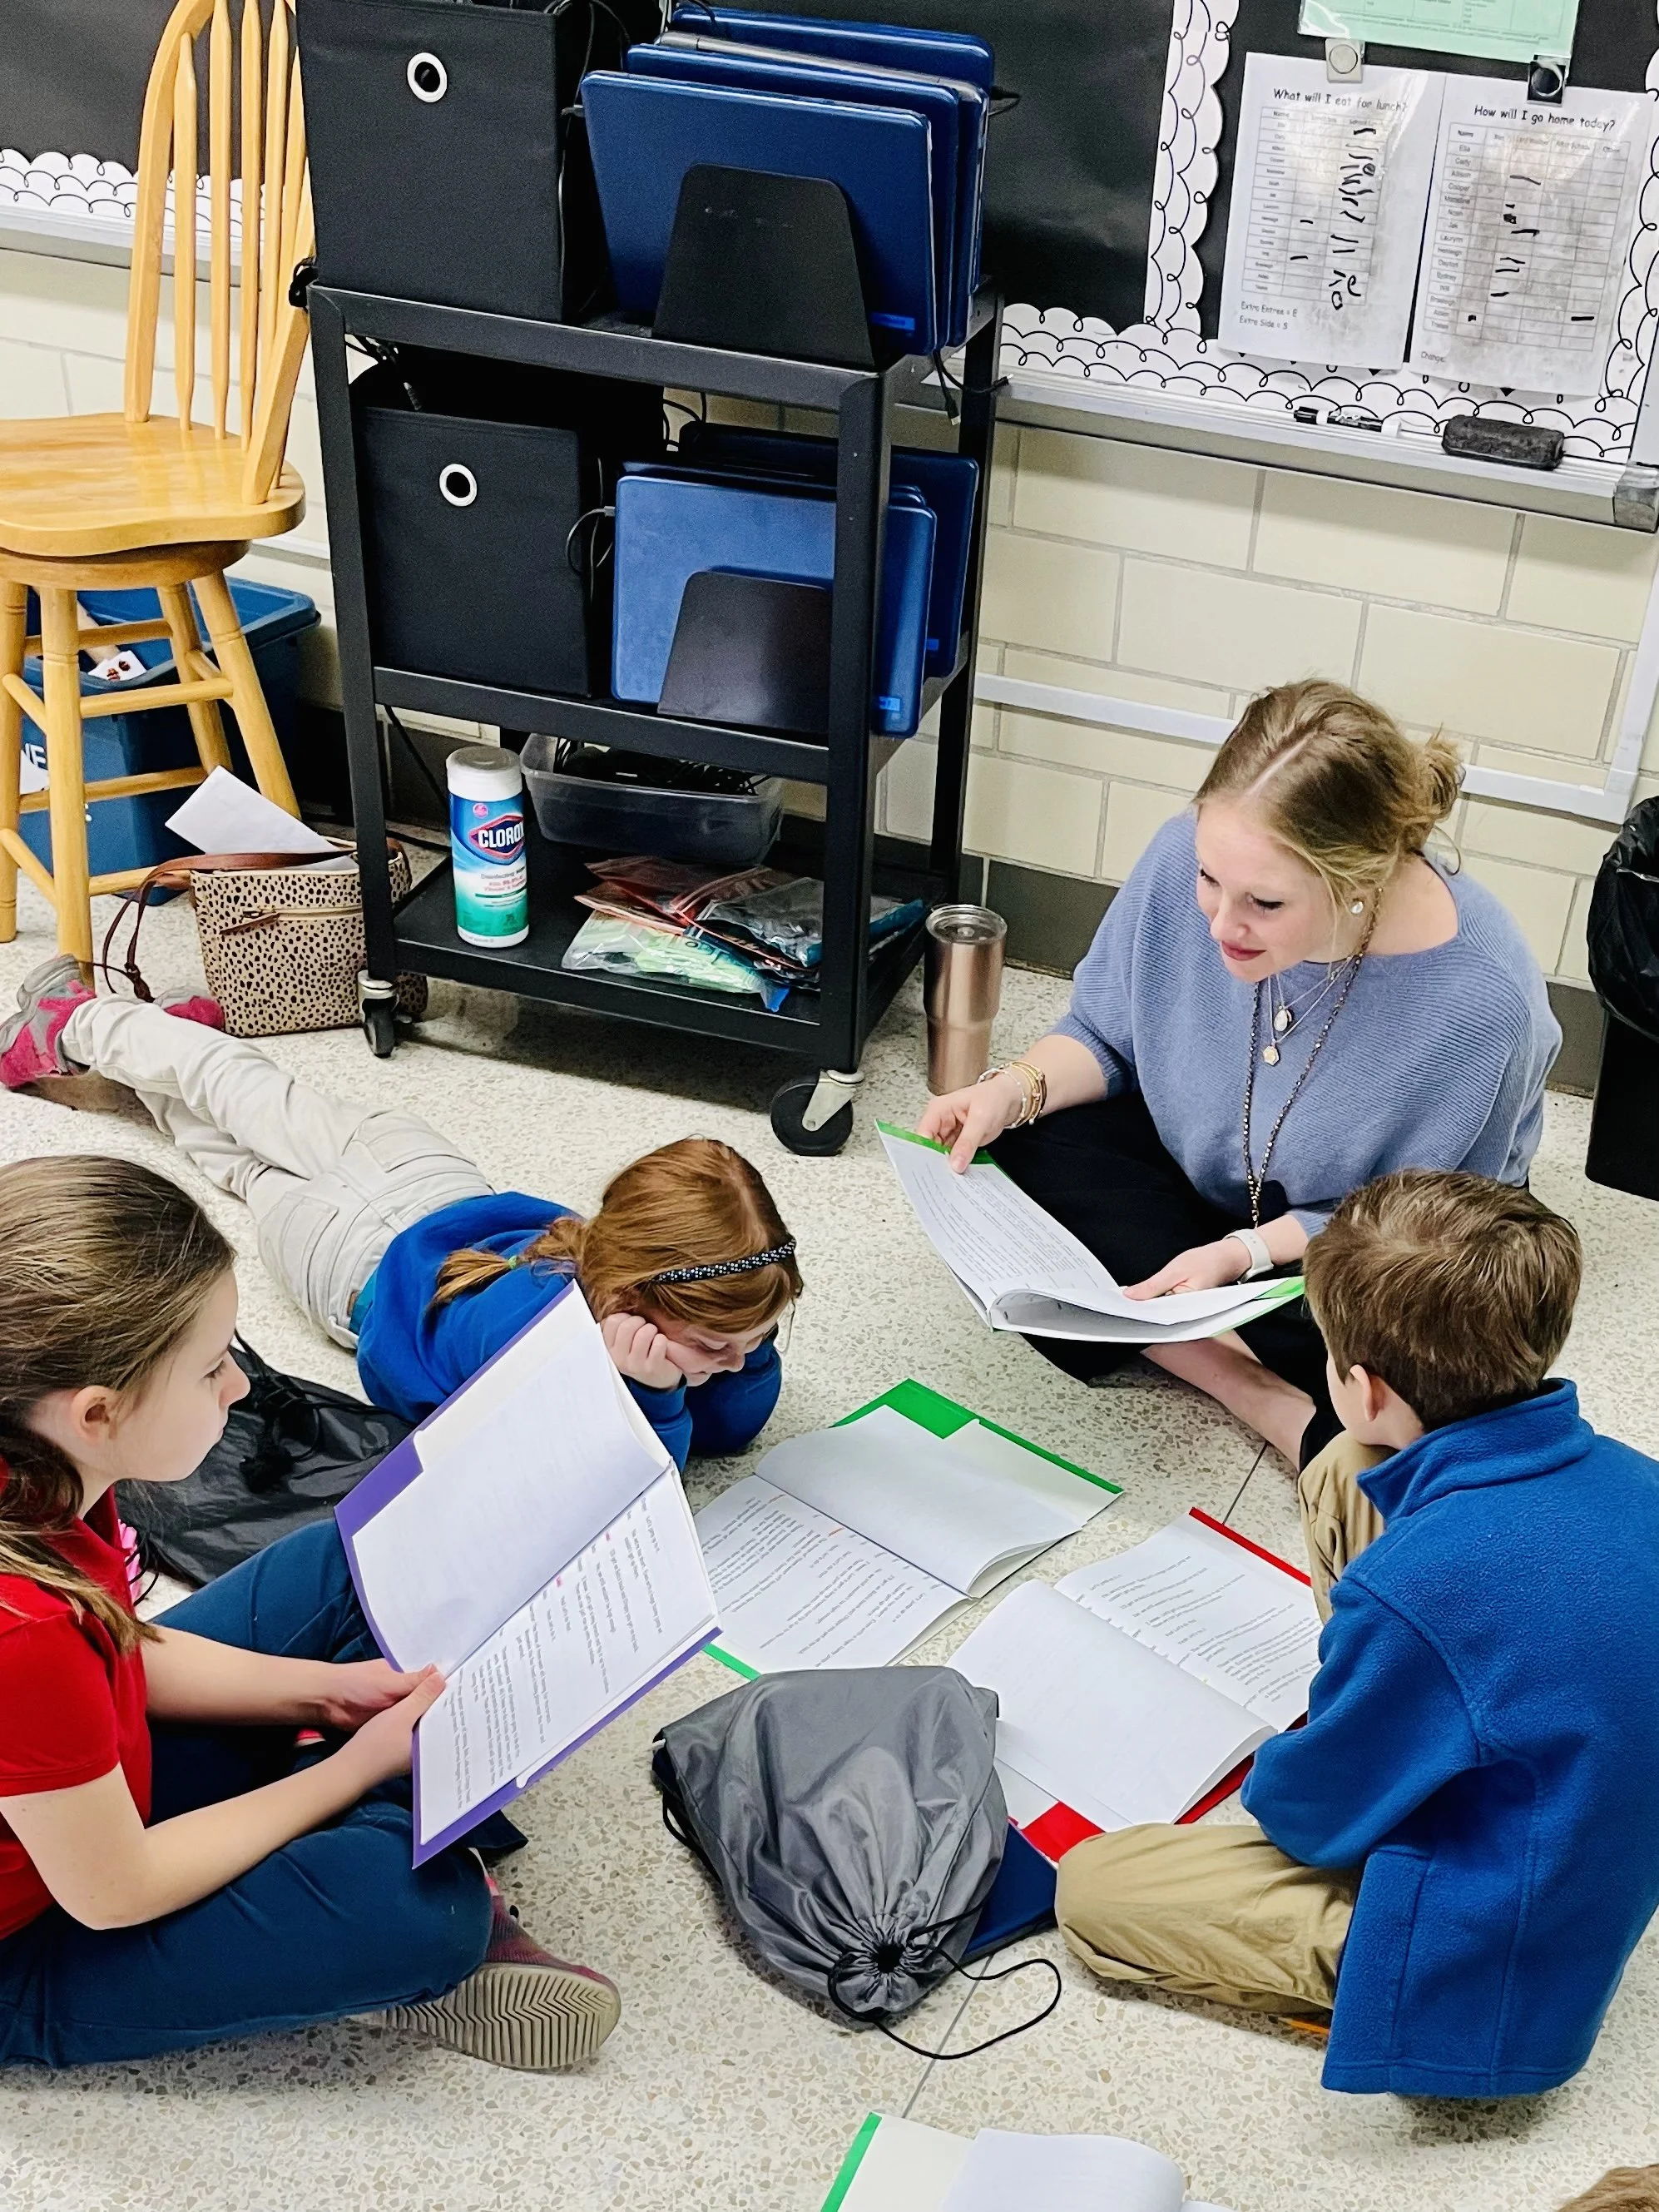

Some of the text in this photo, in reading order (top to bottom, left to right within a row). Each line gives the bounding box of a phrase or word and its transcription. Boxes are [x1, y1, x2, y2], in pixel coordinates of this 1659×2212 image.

[1274, 88, 1300, 102] What
[1305, 92, 1321, 103] will
[1325, 93, 1332, 104] I
[1335, 97, 1352, 107] eat
[1357, 98, 1372, 108] for
[1474, 105, 1616, 132] How will I go home today?
[1241, 301, 1260, 312] Extra
[1239, 315, 1258, 325] Extra
[1260, 317, 1275, 328] Side
